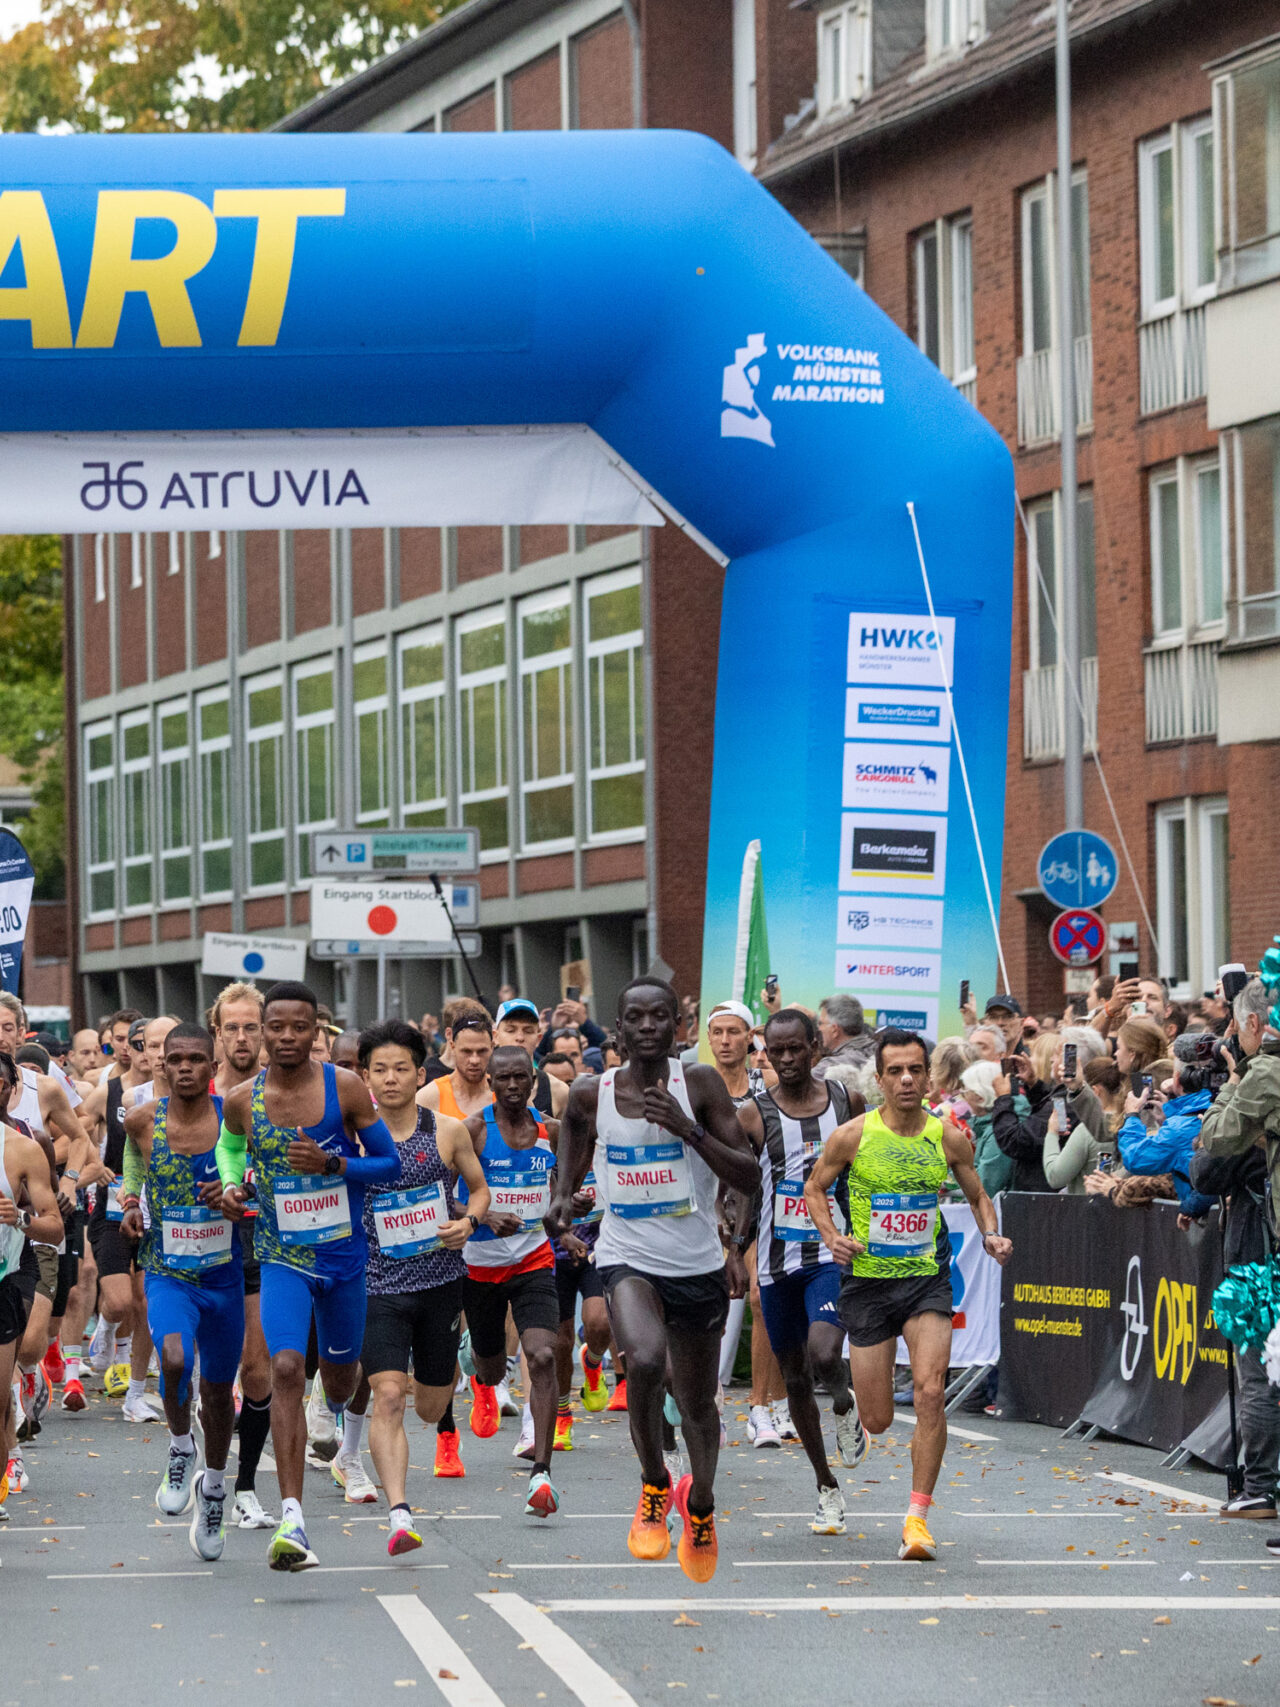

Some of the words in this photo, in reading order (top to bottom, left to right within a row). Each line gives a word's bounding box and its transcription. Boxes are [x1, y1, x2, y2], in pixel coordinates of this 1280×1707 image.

[777, 344, 879, 367] VOLKSBANK
[792, 363, 882, 385] MÜNSTER
[772, 385, 884, 404] MARATHON
[160, 469, 370, 509] ATRUVIA
[860, 628, 924, 649] HWK
[856, 764, 916, 776] SCHMITZ
[424, 838, 467, 849] Theater
[324, 888, 374, 901] Eingang
[378, 887, 440, 900] Startblock
[212, 937, 249, 949] Eingang
[859, 963, 931, 978] INTERSPORT
[617, 1169, 678, 1186] SAMUEL
[284, 1194, 339, 1213] GODWIN
[496, 1192, 542, 1204] STEPHEN
[383, 1206, 436, 1230] RYUICHI
[880, 1212, 928, 1233] 4366
[171, 1226, 224, 1240] BLESSING
[1153, 1276, 1197, 1386] OPEL
